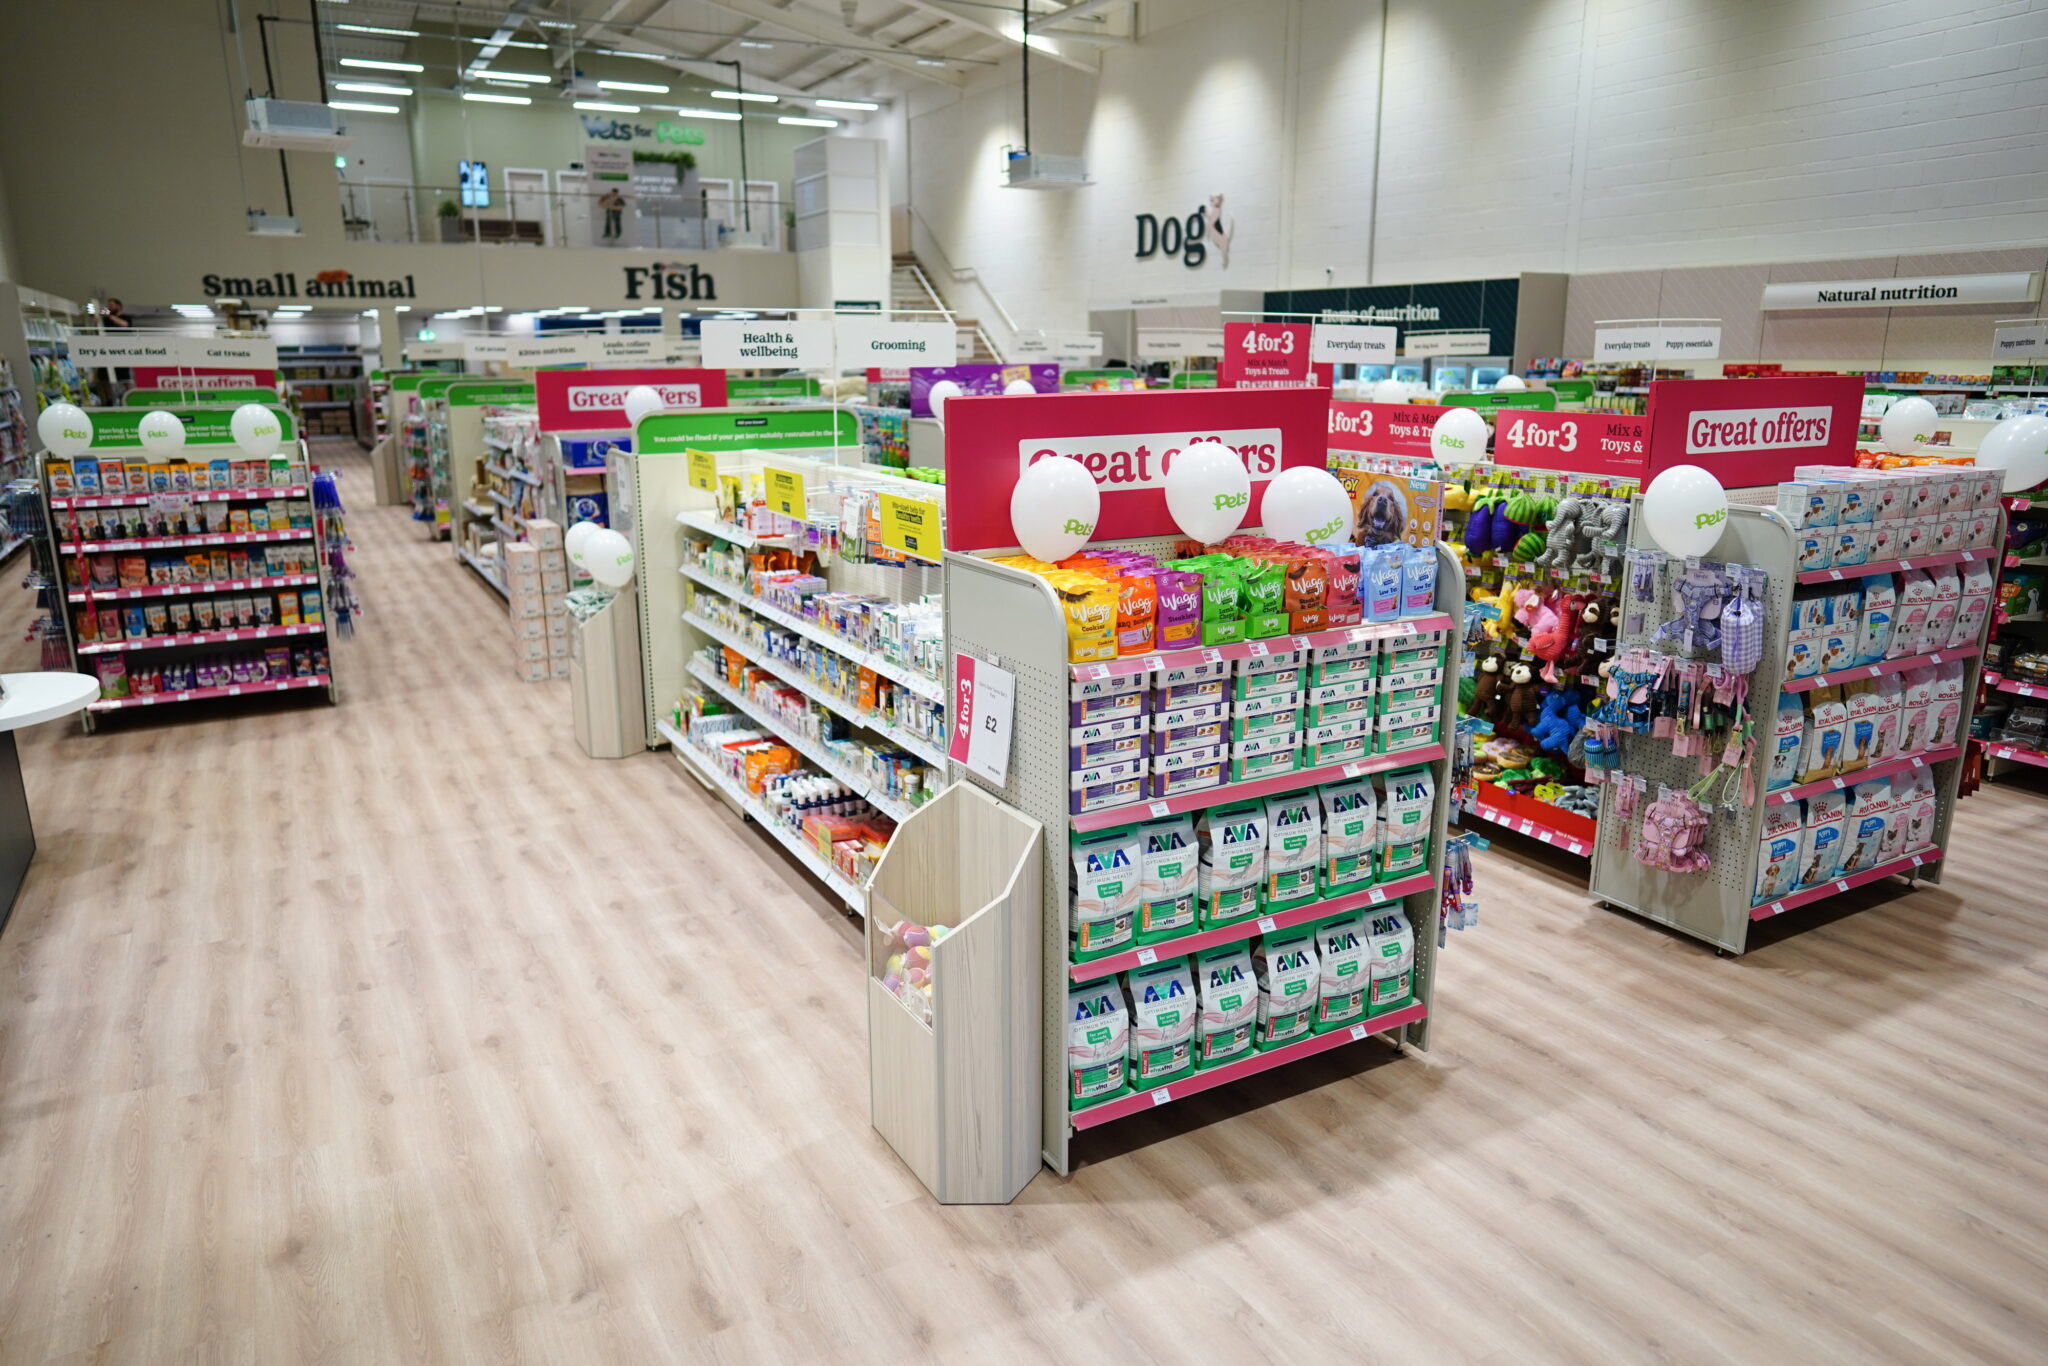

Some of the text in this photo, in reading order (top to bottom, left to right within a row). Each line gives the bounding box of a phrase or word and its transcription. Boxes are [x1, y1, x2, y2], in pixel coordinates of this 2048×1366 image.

[580, 115, 705, 146] Vets for Pets
[1135, 205, 1206, 267] Dog
[203, 273, 416, 298] Small animal
[624, 262, 717, 300] Fish
[1817, 285, 1958, 302] Natural nutrition
[1321, 304, 1441, 323] Home of nutrition
[743, 332, 794, 343] Health &
[1327, 340, 1386, 350] Everyday treats
[1666, 341, 1684, 349] Puppy
[79, 348, 97, 356] Dry
[145, 347, 166, 355] food
[740, 346, 799, 359] wellbeing
[871, 340, 926, 352] Grooming
[1604, 341, 1632, 351] Everyday
[1268, 358, 1288, 366] Match
[1245, 368, 1261, 376] Toys
[1268, 367, 1289, 375] Treats
[160, 376, 253, 388] Great offers
[1393, 412, 1410, 423] Mix
[1412, 414, 1420, 423] &
[63, 429, 88, 439] Pets
[1389, 424, 1411, 438] Toys
[1412, 425, 1420, 436] &
[1606, 424, 1642, 437] Mix &
[1692, 411, 1827, 448] Great offers
[1439, 434, 1465, 449] Pets
[1601, 439, 1643, 454] Toys &
[1409, 480, 1427, 491] New
[1213, 492, 1247, 510] Pets
[1694, 507, 1727, 530] Pets
[1064, 519, 1093, 536] Pets
[1305, 516, 1344, 544] Pets
[1372, 570, 1400, 586] Wagg
[1407, 566, 1434, 580] Wagg
[1250, 582, 1281, 599] Wagg
[1291, 577, 1324, 595] Wagg
[1333, 575, 1361, 591] Wagg
[1161, 593, 1198, 612] Wagg
[1208, 587, 1239, 605] Wagg
[1070, 604, 1112, 623] Wagg
[1118, 597, 1153, 616] Wagg
[1081, 624, 1105, 633] Cookies
[1393, 637, 1408, 646] AVA
[1323, 648, 1338, 657] AVA
[1248, 660, 1264, 669] AVA
[1168, 671, 1185, 681] AVA
[1390, 677, 1405, 686] AVA
[1083, 684, 1101, 694] AVA
[1320, 689, 1335, 699] AVA
[1245, 702, 1261, 711] AVA
[986, 715, 997, 733] £2
[1167, 714, 1184, 724] AVA
[1389, 715, 1403, 725] AVA
[1083, 728, 1101, 738] AVA
[1317, 729, 1333, 739] AVA
[1244, 742, 1260, 752] AVA
[1166, 756, 1182, 766] AVA
[1083, 772, 1100, 782] AVA
[1396, 783, 1428, 802] AVA
[1333, 793, 1369, 813] AVA
[1277, 806, 1311, 826] AVA
[1223, 823, 1260, 844] AVA
[1147, 832, 1187, 853] AVA
[1087, 849, 1131, 873] AVA
[1373, 915, 1401, 936] AVA
[1328, 933, 1360, 954] AVA
[1277, 951, 1310, 972] AVA
[1210, 965, 1245, 988] AVA
[1143, 979, 1185, 1004] AVA
[1075, 995, 1115, 1021] AVA
